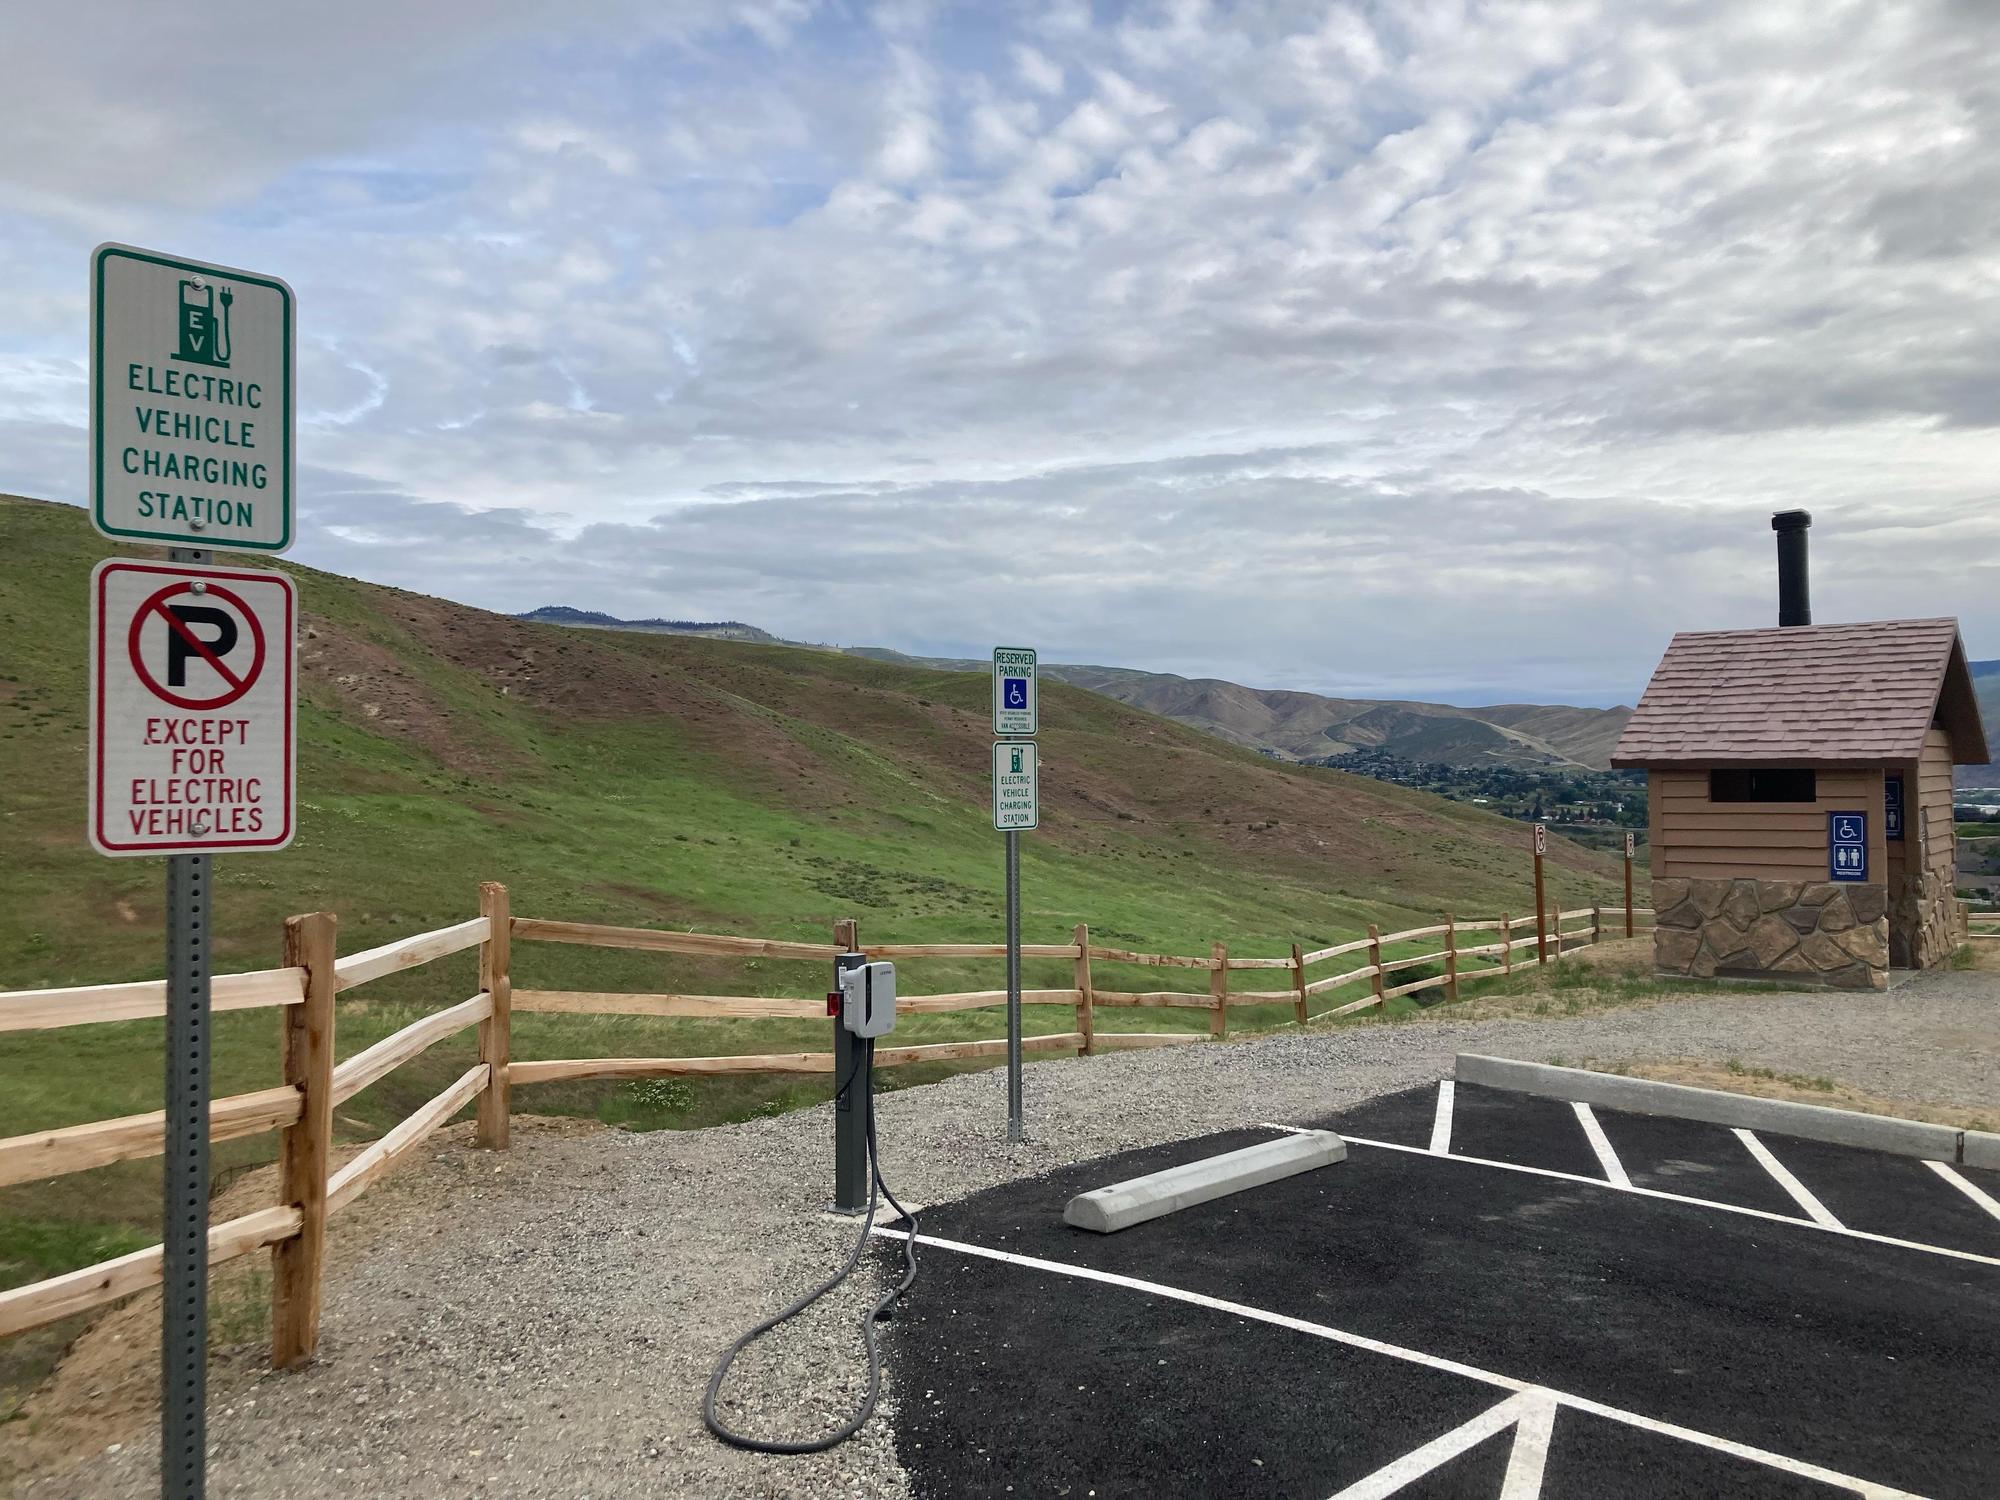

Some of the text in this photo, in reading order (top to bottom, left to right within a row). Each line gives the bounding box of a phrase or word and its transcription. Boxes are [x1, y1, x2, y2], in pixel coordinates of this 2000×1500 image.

[189, 311, 204, 351] EV
[129, 363, 262, 409] ELECTRIC
[136, 406, 256, 448] VEHICLE
[123, 447, 267, 489] CHARGING
[138, 491, 253, 528] STATION
[168, 605, 238, 687] P
[996, 652, 1034, 665] RESERVED
[999, 665, 1032, 677] PARKING
[145, 718, 250, 745] EXCEPT
[172, 749, 225, 775] FOR
[132, 778, 262, 805] ELECTRIC
[1001, 775, 1031, 785] ELECTRIC
[1002, 788, 1029, 798] VEHICLE
[999, 800, 1032, 811] CHARGING
[1003, 813, 1029, 823] STATION
[129, 808, 263, 835] VEHICLES
